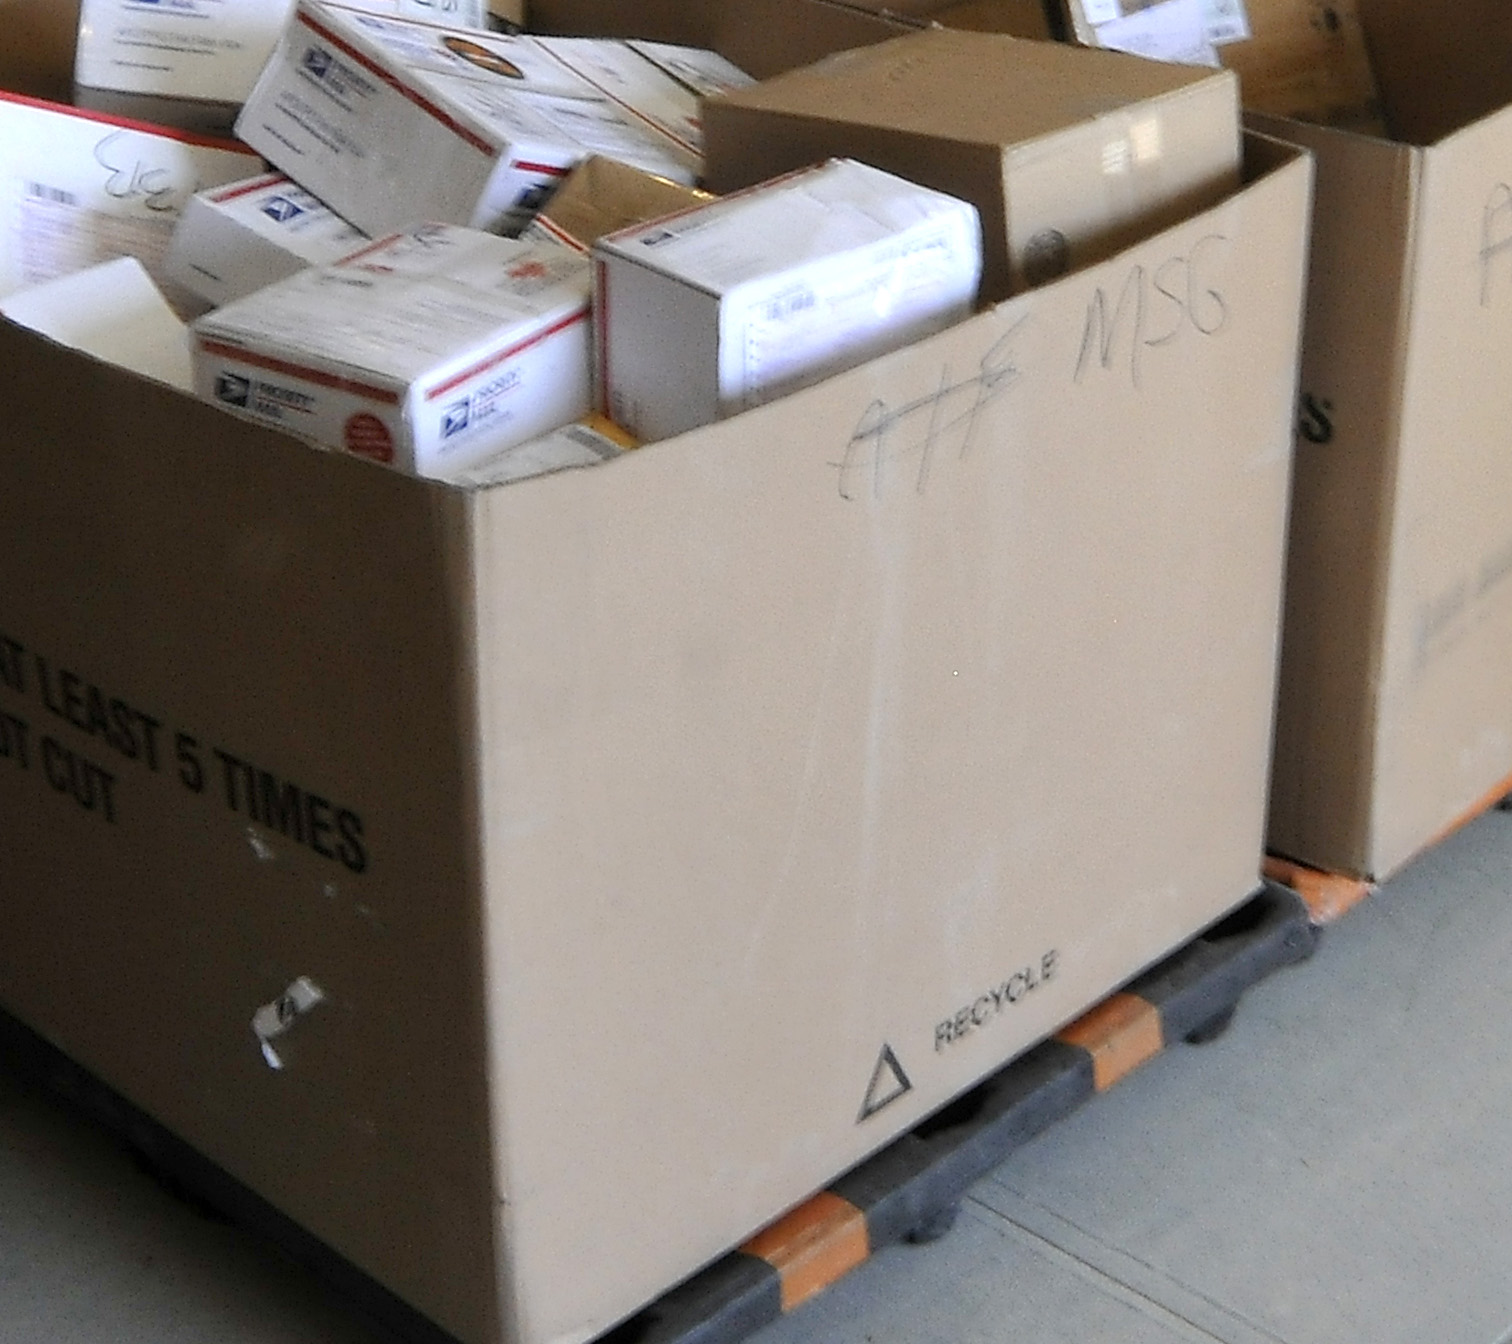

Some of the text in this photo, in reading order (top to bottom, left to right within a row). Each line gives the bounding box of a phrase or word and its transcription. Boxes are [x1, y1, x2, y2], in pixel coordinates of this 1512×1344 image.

[35, 654, 163, 773] LEAST
[174, 732, 204, 794] 5
[214, 746, 368, 875] TIMES
[40, 734, 118, 825] CUT
[934, 948, 1060, 1053] RECYCLE
